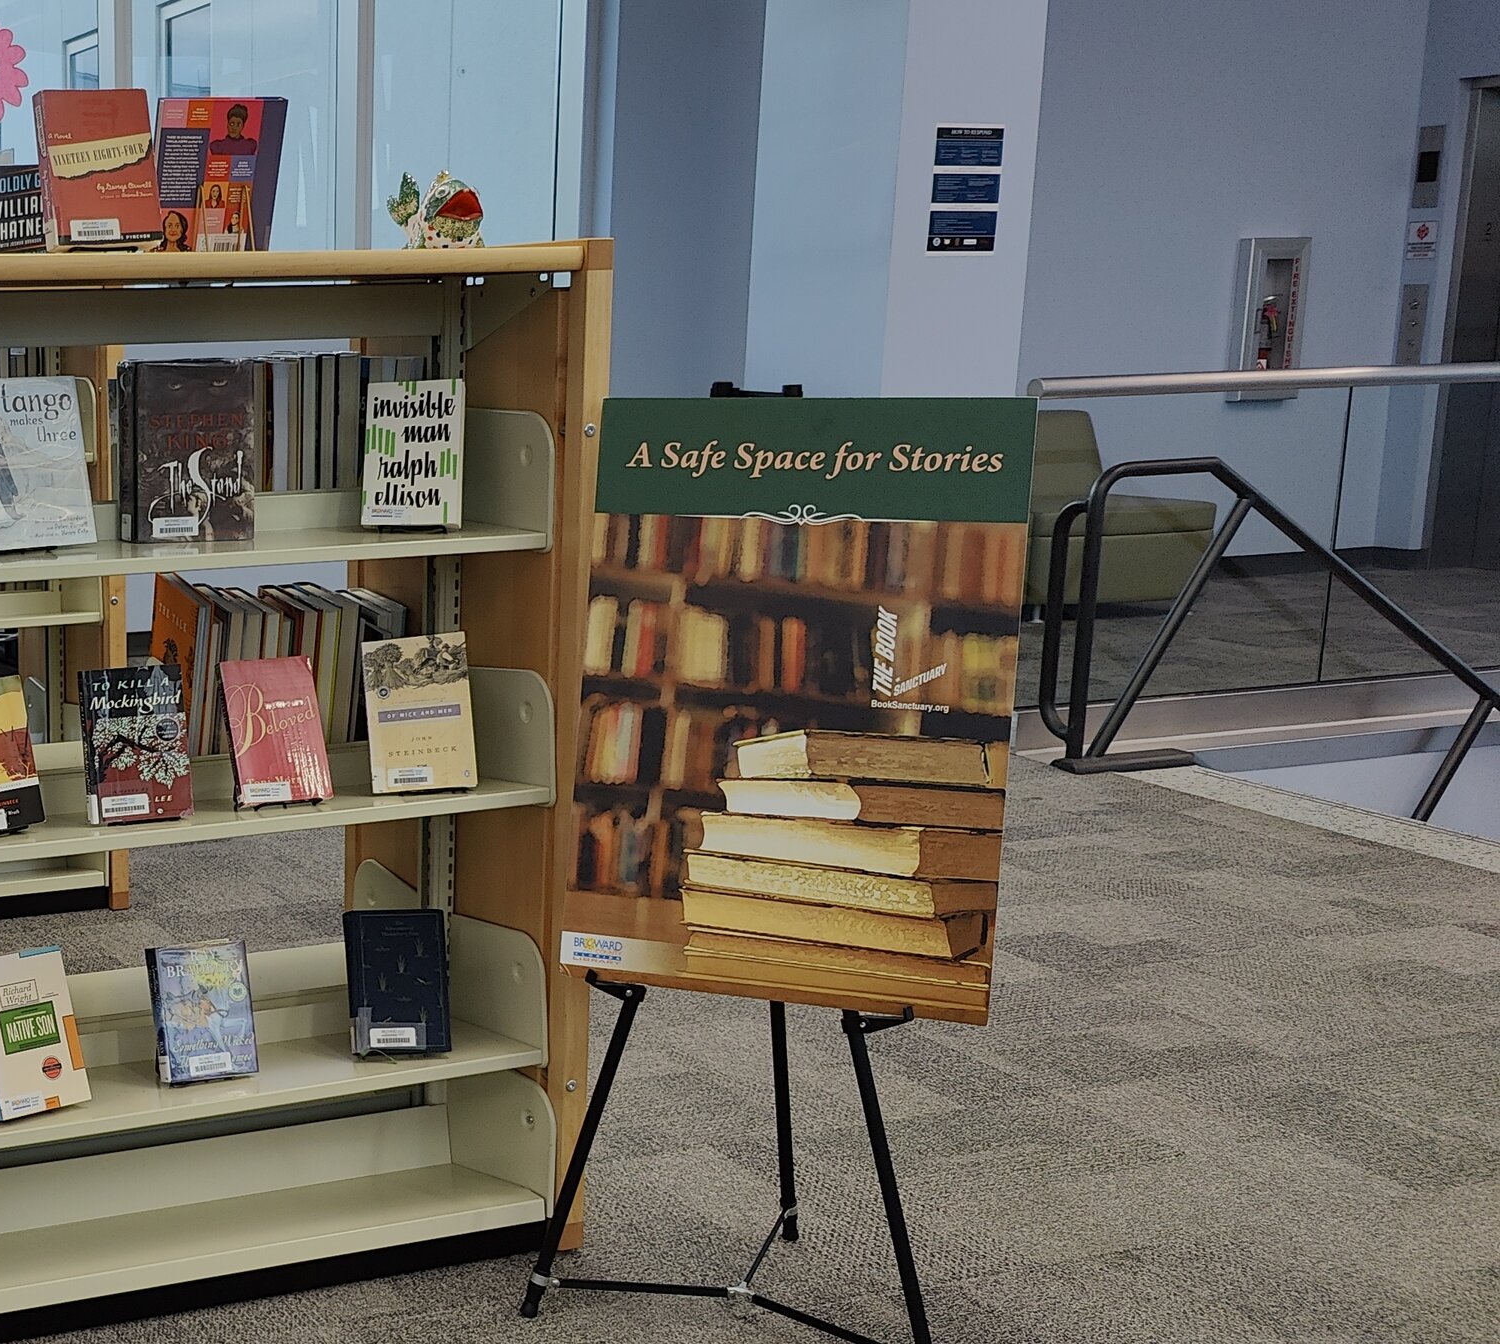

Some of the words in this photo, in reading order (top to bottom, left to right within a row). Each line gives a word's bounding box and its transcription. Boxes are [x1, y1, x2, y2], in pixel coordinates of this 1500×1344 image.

[52, 152, 92, 167] NINETEEN
[93, 142, 145, 161] EIGHTY-FOUR
[105, 182, 127, 192] George
[128, 181, 152, 189] Orwell
[1291, 258, 1300, 288] FIRE
[1, 383, 73, 421] tango
[373, 390, 456, 419] invisible
[9, 415, 44, 426] makes
[151, 413, 245, 428] STEPHEN
[36, 426, 77, 443] three
[167, 434, 228, 449] KING
[401, 423, 451, 443] man
[377, 449, 438, 486] ralph
[626, 441, 653, 469] A
[661, 439, 725, 478] Safe
[734, 441, 826, 479] Space
[825, 441, 882, 480] for
[889, 443, 1004, 474] Stories
[157, 460, 192, 514] The
[375, 482, 441, 508] ellison
[873, 605, 899, 662] BOOK
[92, 682, 110, 692] TO
[117, 680, 154, 689] KILL
[160, 678, 170, 686] A
[871, 657, 895, 698] THE
[894, 662, 948, 697] SANCTUARY
[89, 691, 181, 715] Mockingbird
[871, 698, 950, 714] BookSanctuary.org
[225, 681, 316, 759] Beloved
[388, 746, 457, 757] STEINBECK
[154, 794, 173, 803] LEE
[573, 937, 622, 951] BROWARD
[3, 983, 32, 995] Richard
[6, 994, 32, 1005] Wright
[5, 1019, 36, 1044] NATIVE
[37, 1013, 57, 1037] SON
[173, 1038, 218, 1053] Something
[223, 1032, 255, 1046] Wicked
